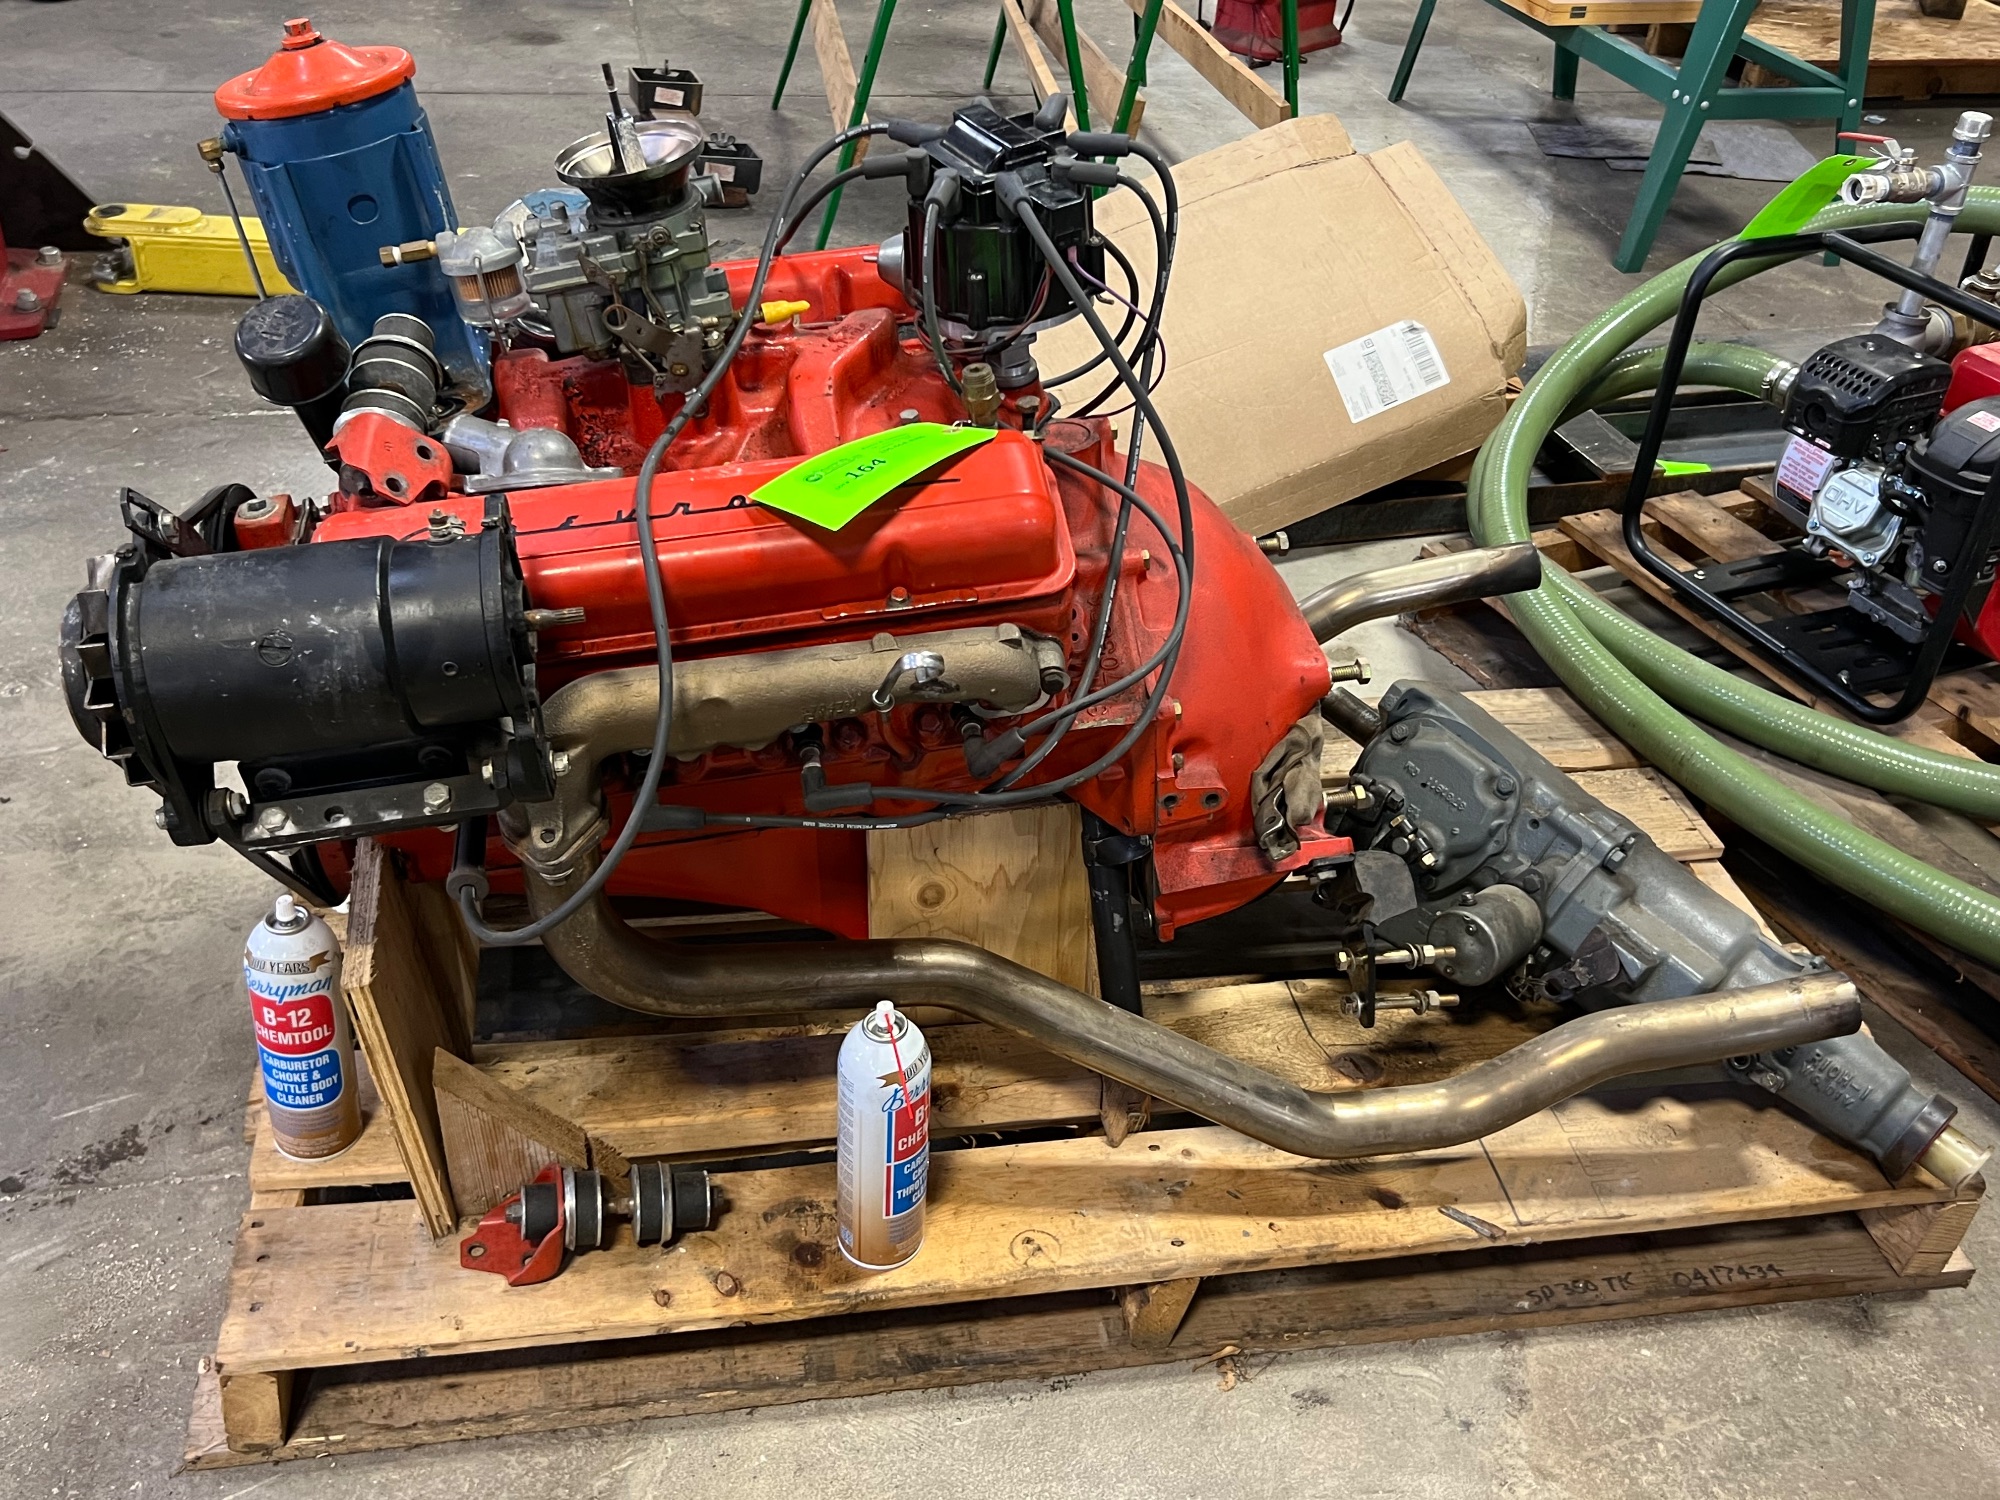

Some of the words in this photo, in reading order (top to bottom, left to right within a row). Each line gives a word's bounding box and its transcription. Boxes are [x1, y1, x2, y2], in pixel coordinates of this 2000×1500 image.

[845, 457, 887, 480] 164
[1824, 486, 1869, 515] OHV
[269, 960, 310, 973] YEARS
[262, 1006, 313, 1028] B-12
[255, 1024, 332, 1045] CHEMTOOL
[263, 1053, 330, 1071] CARBURETOR
[272, 1068, 308, 1082] CHOKE
[312, 1070, 321, 1080] &
[311, 1073, 339, 1092] BODY
[276, 1091, 324, 1105] CLEANER
[1601, 1271, 1635, 1292] TK
